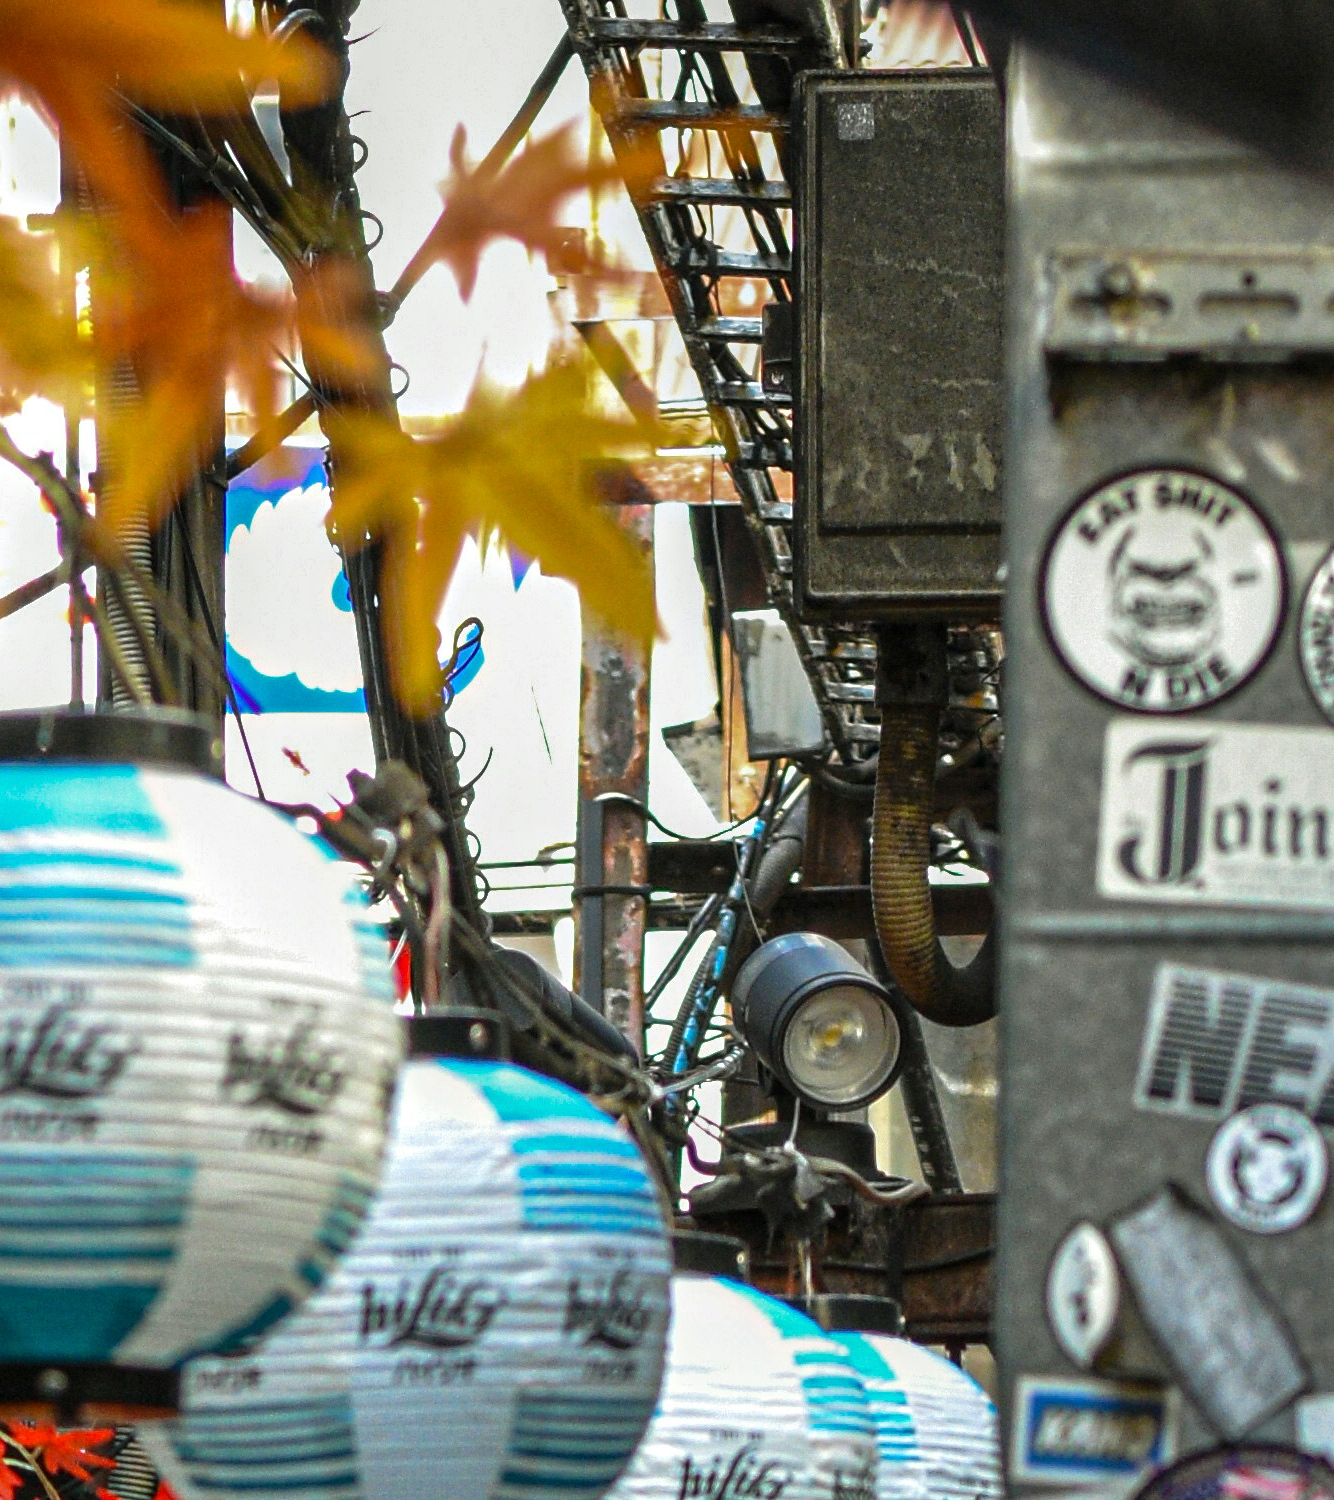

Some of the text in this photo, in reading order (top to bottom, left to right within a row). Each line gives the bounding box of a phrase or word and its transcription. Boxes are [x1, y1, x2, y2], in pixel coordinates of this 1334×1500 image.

[1078, 484, 1235, 543] EAT SHIT
[1168, 657, 1229, 698] DIE
